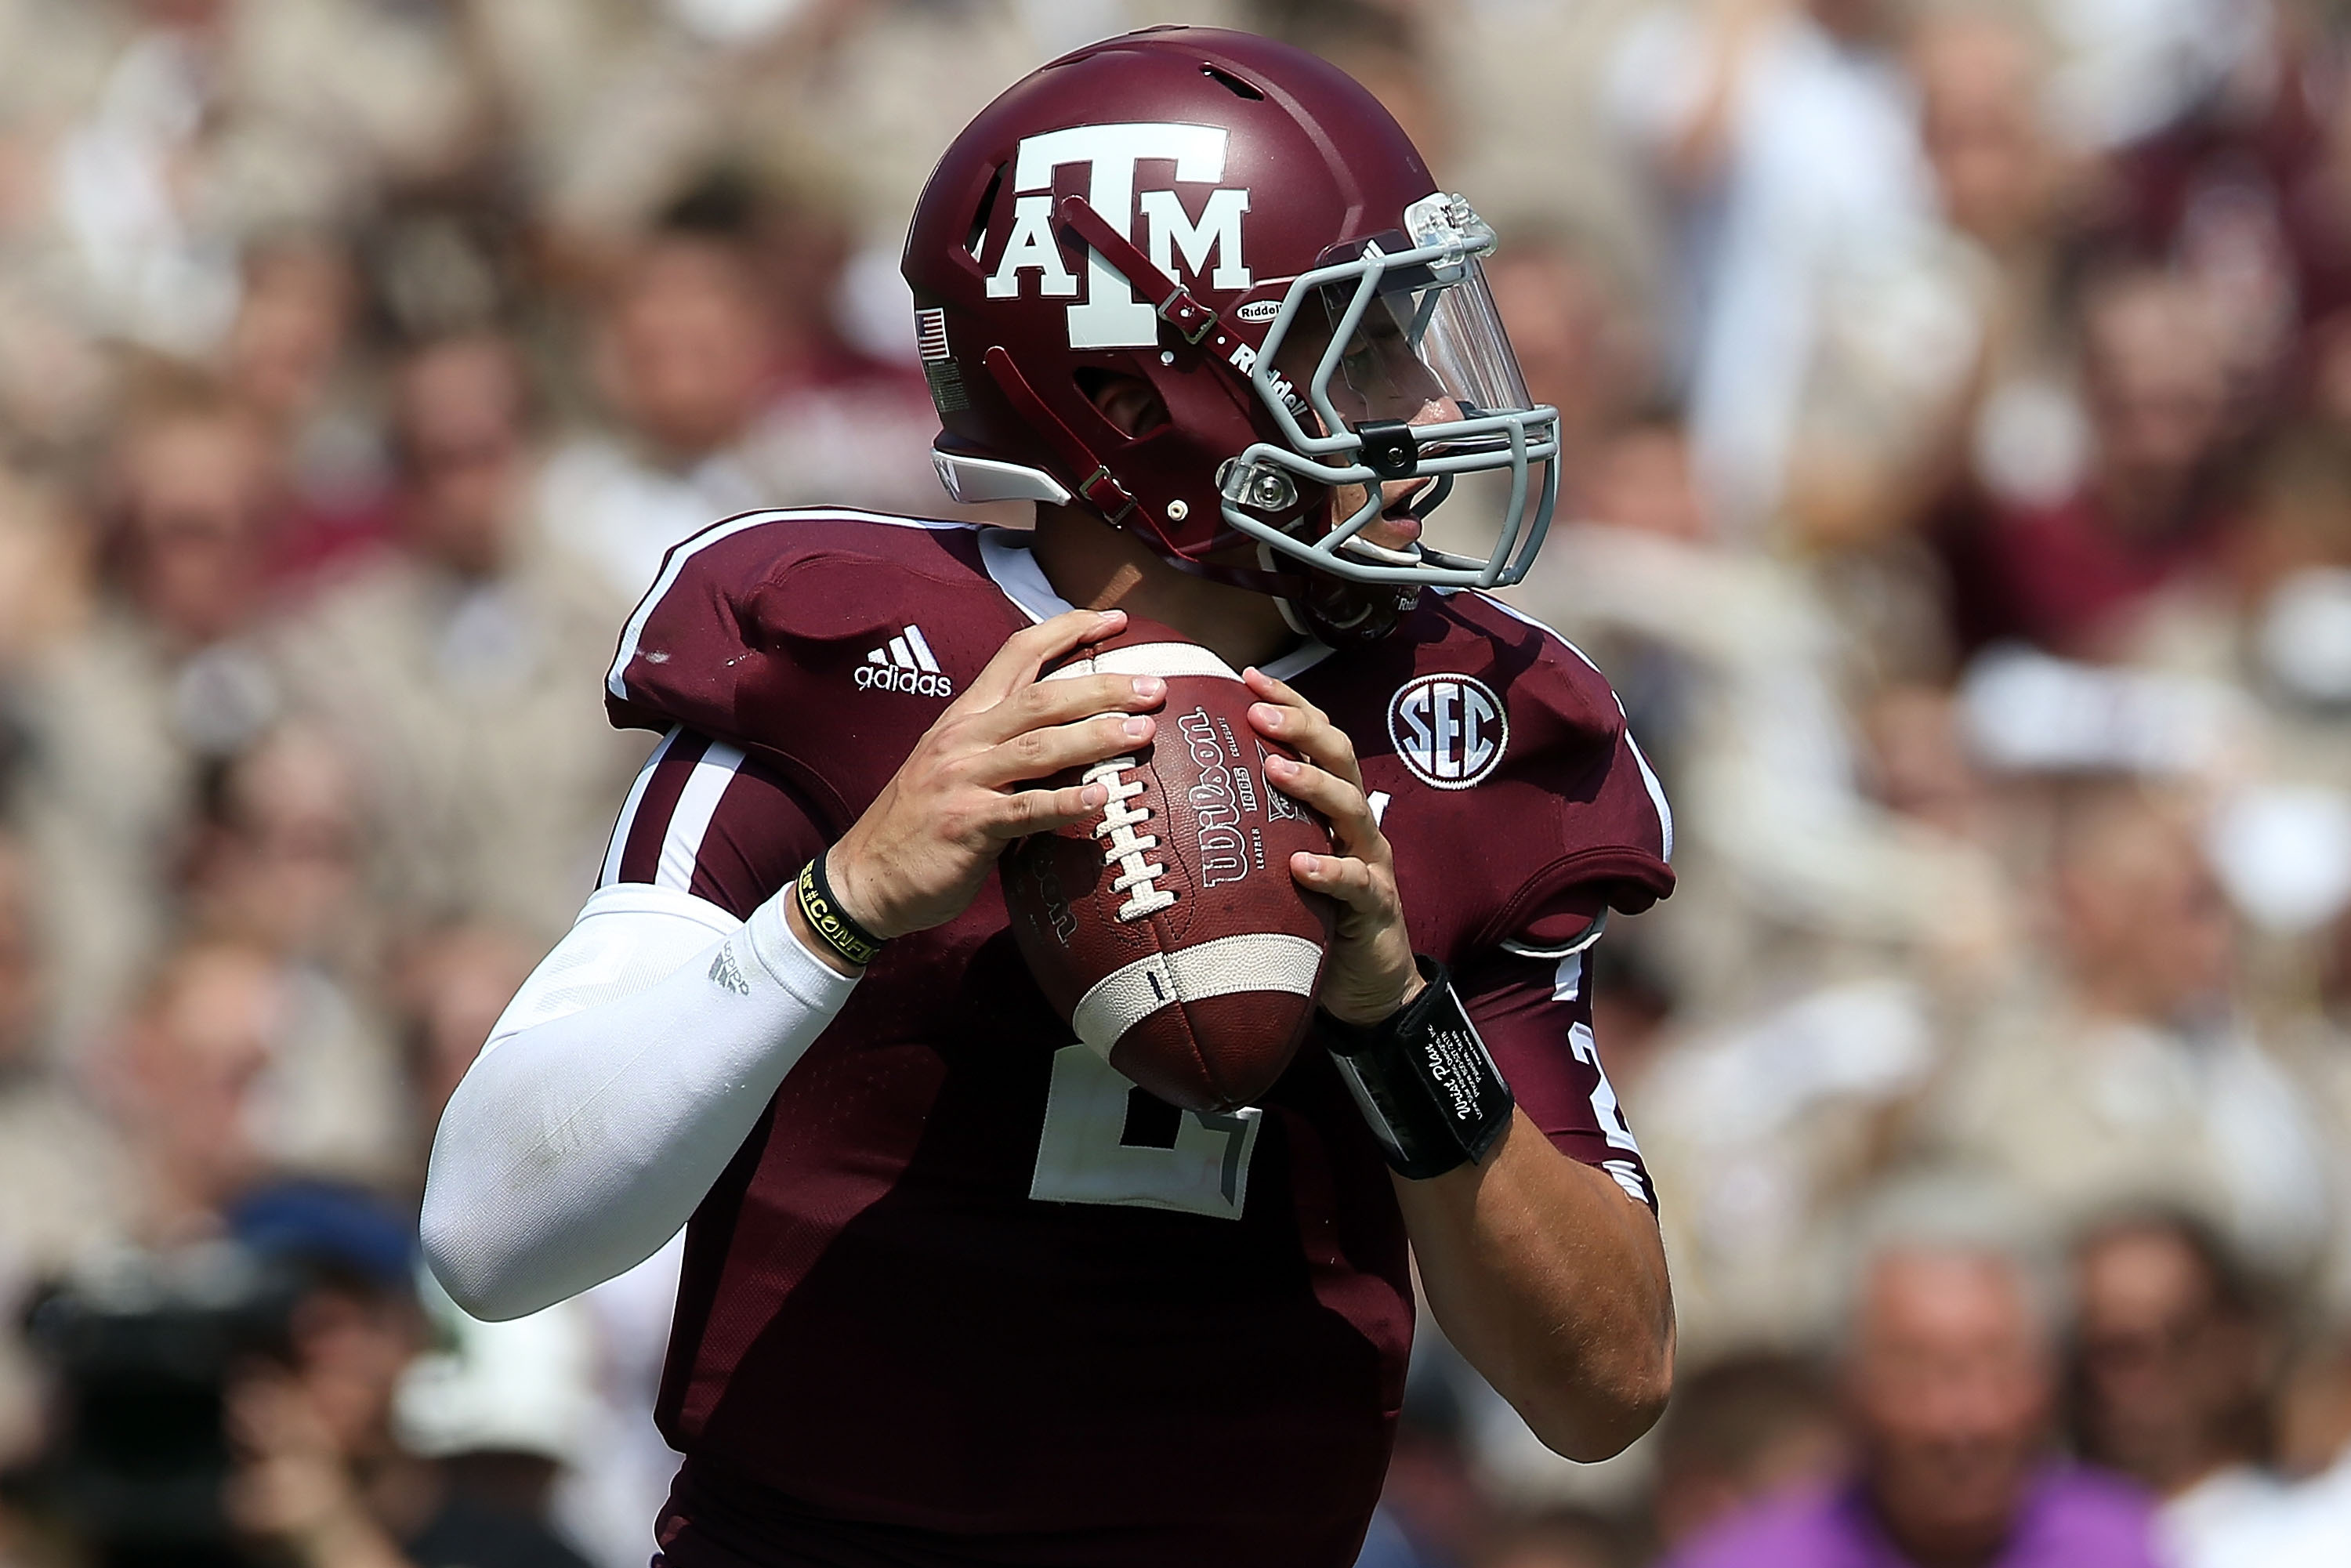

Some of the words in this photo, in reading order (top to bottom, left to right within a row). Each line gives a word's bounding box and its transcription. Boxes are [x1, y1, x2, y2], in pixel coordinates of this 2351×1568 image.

[1241, 303, 1283, 318] Riddel
[854, 664, 951, 697] adidas
[1399, 683, 1495, 778] SEC
[1177, 709, 1249, 888] Wilson
[1252, 828, 1266, 870] LEATHER
[723, 940, 749, 996] adidas
[1425, 1043, 1450, 1081] Plan
[1443, 1078, 1470, 1120] Wrist
